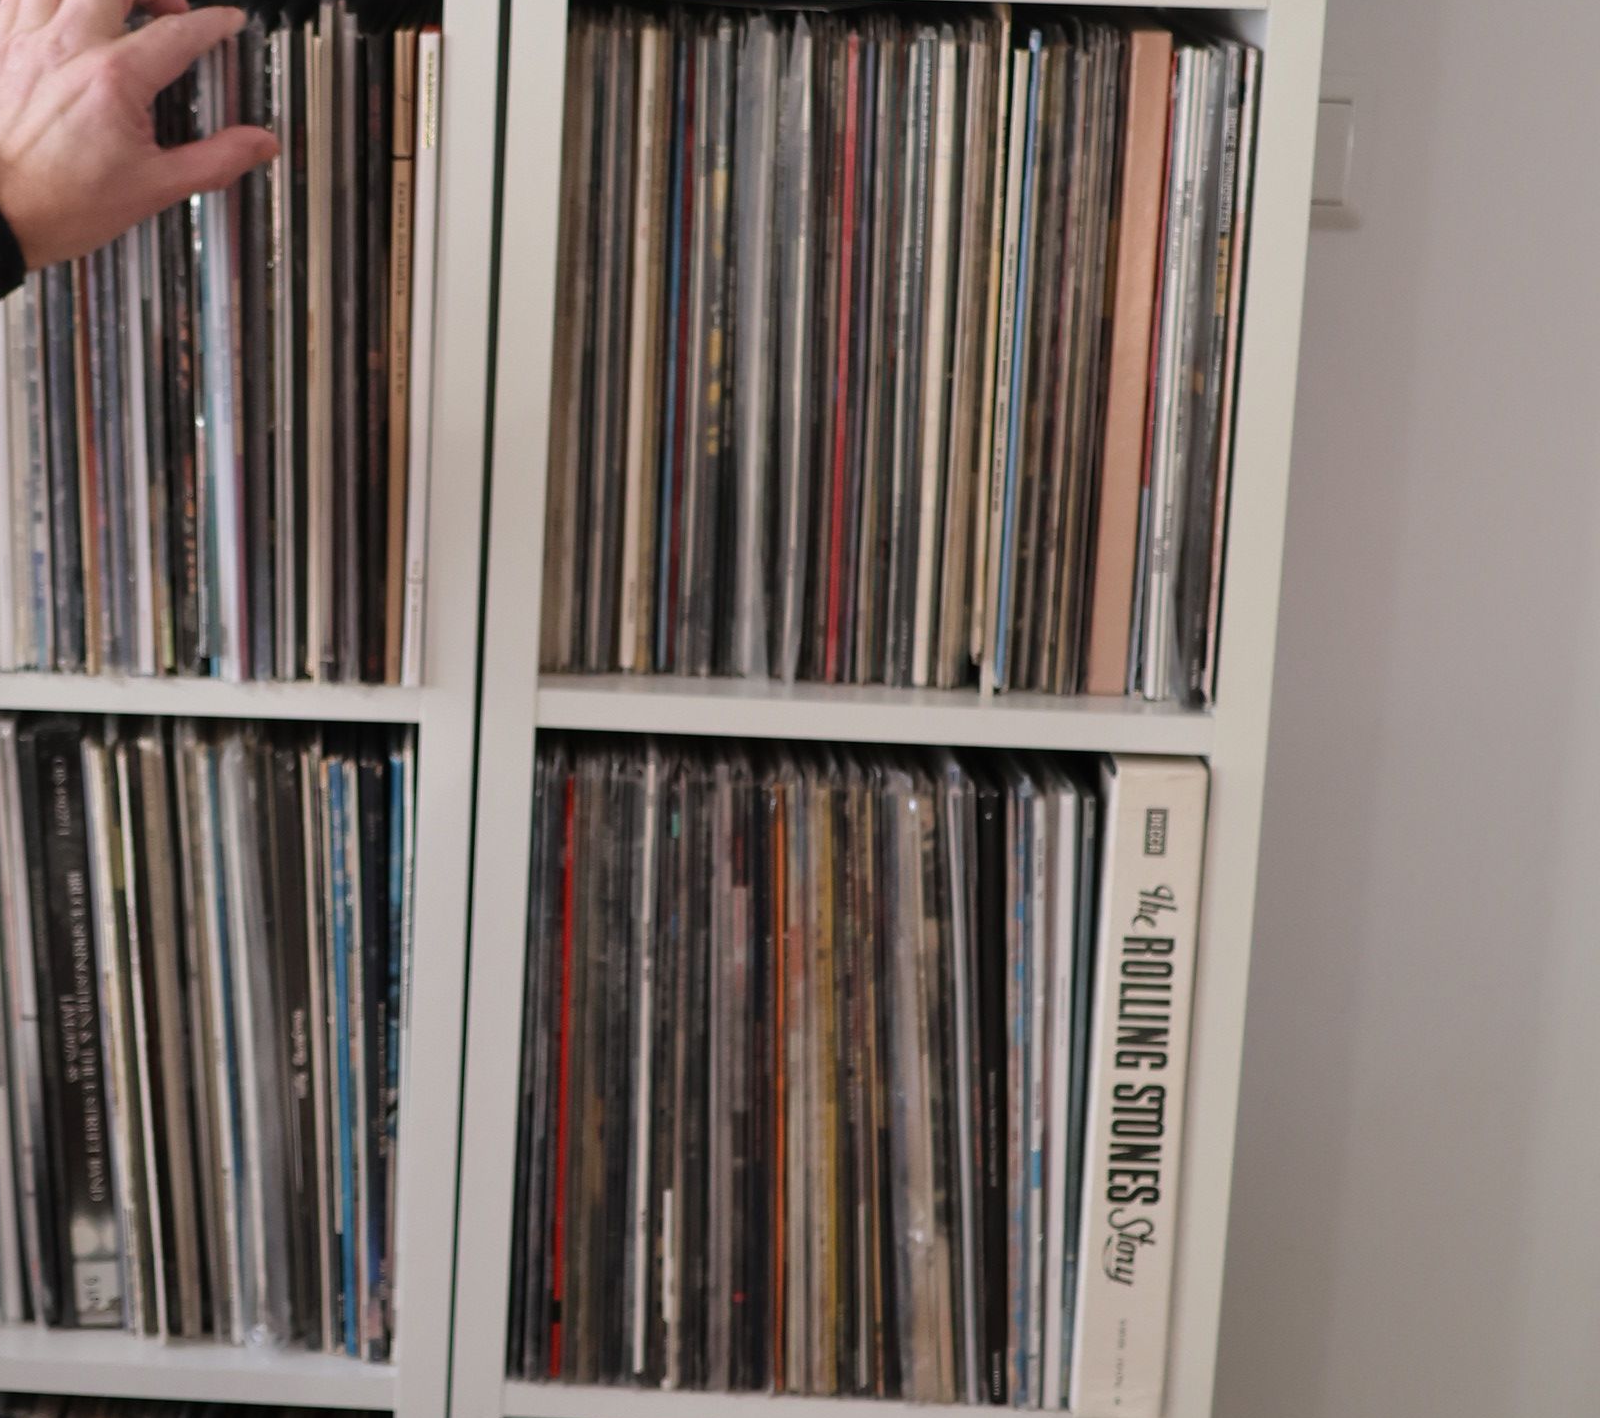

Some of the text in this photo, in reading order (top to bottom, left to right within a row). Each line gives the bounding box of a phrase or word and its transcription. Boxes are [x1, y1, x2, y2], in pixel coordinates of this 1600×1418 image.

[1147, 810, 1166, 855] DECCA
[1103, 883, 1178, 1287] The ROLLING STONES Story
